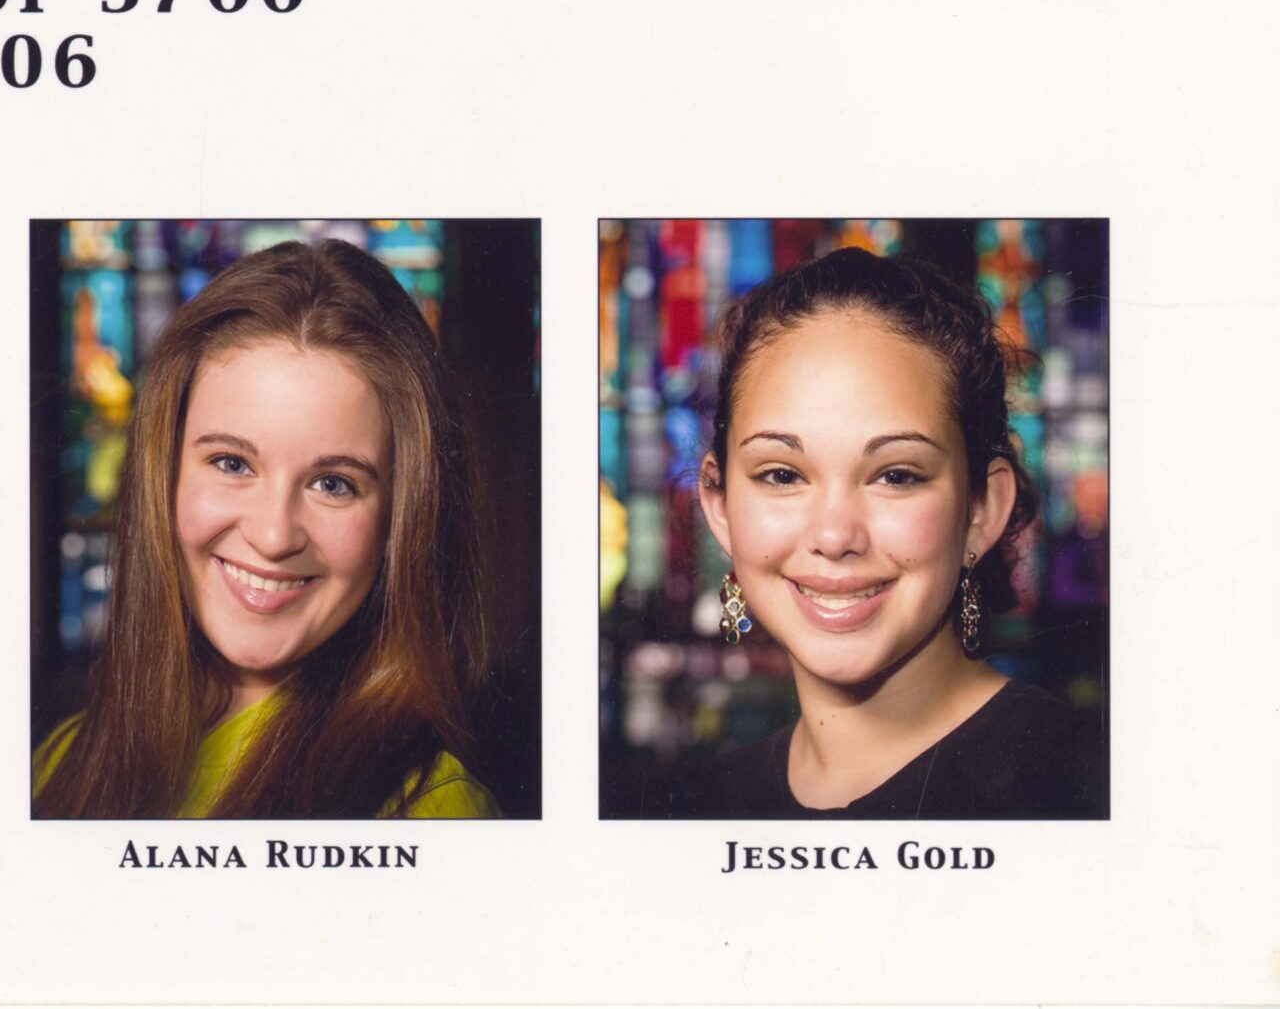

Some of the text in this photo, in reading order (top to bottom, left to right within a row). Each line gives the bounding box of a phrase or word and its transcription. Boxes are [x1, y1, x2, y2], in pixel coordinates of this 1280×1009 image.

[118, 839, 419, 869] ALANA RUDKIN
[721, 840, 995, 873] JESSICA GOLD
